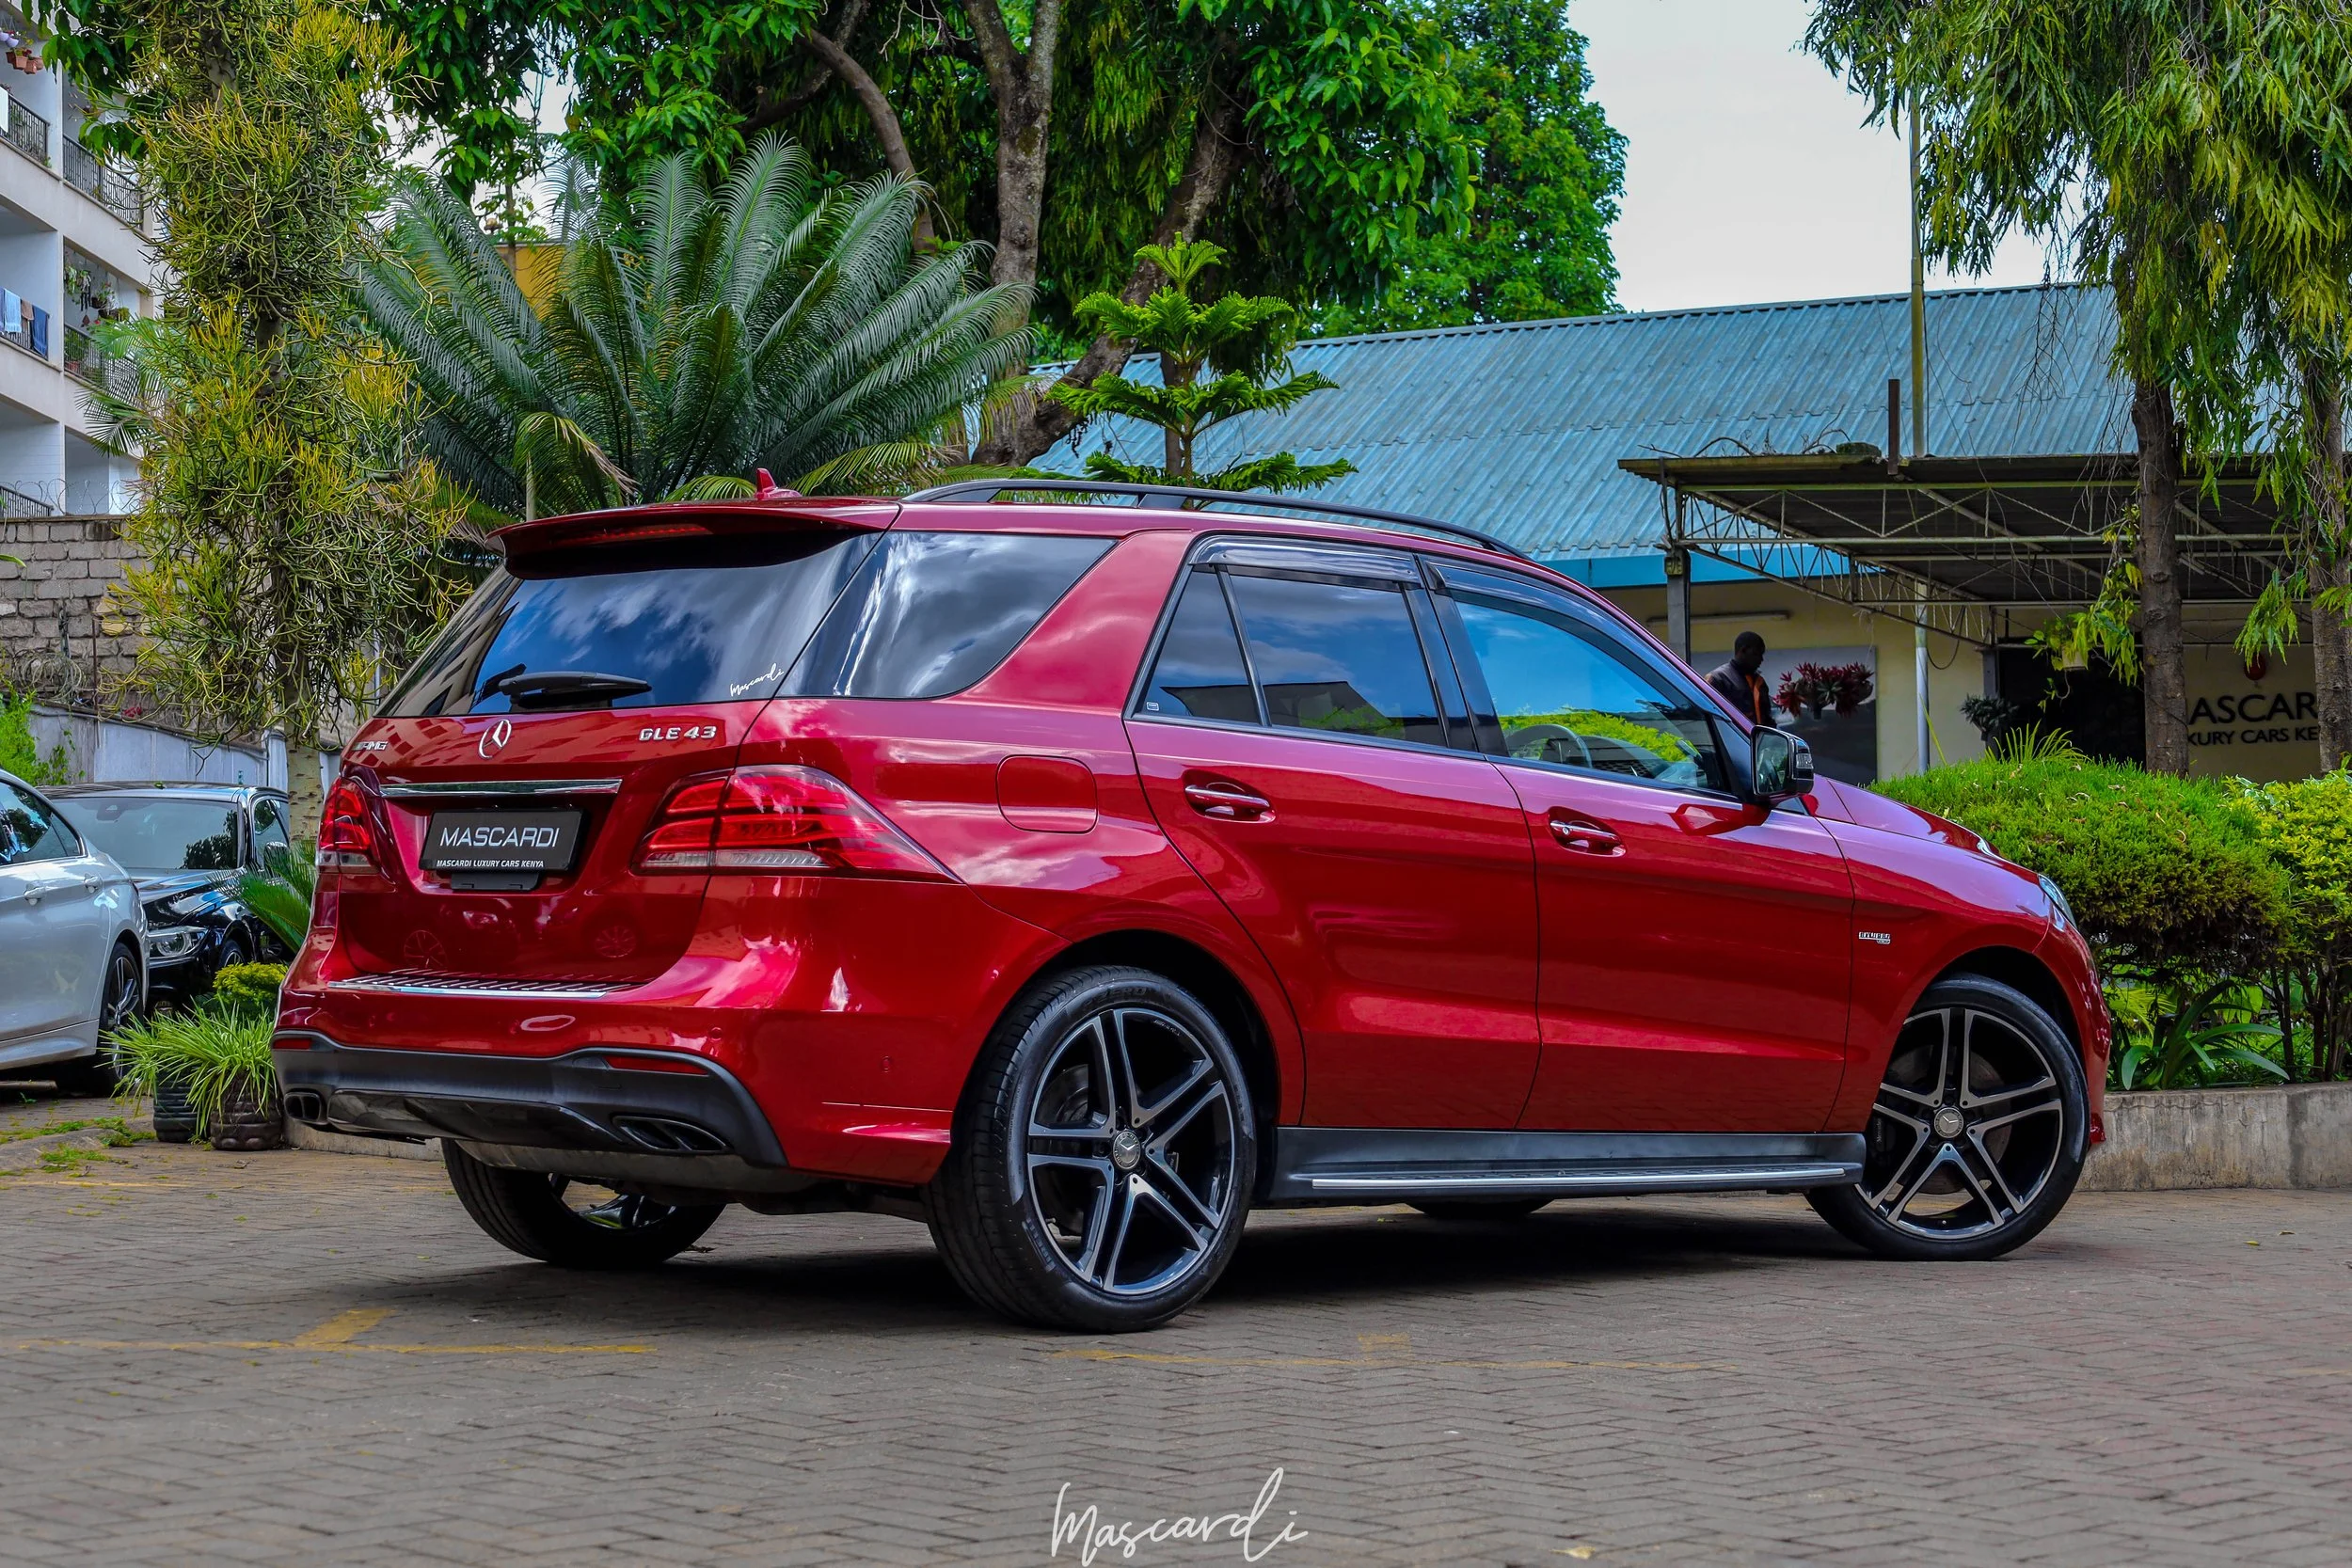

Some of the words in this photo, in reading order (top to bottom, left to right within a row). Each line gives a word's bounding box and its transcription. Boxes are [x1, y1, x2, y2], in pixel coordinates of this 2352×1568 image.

[730, 662, 785, 697] Mascardi
[2188, 692, 2319, 725] ASCAR
[639, 727, 681, 741] GLE
[684, 726, 717, 739] 43
[2241, 728, 2289, 744] CARS
[2296, 726, 2320, 742] KE
[439, 827, 560, 847] MASCARDI
[520, 860, 544, 868] KENYA
